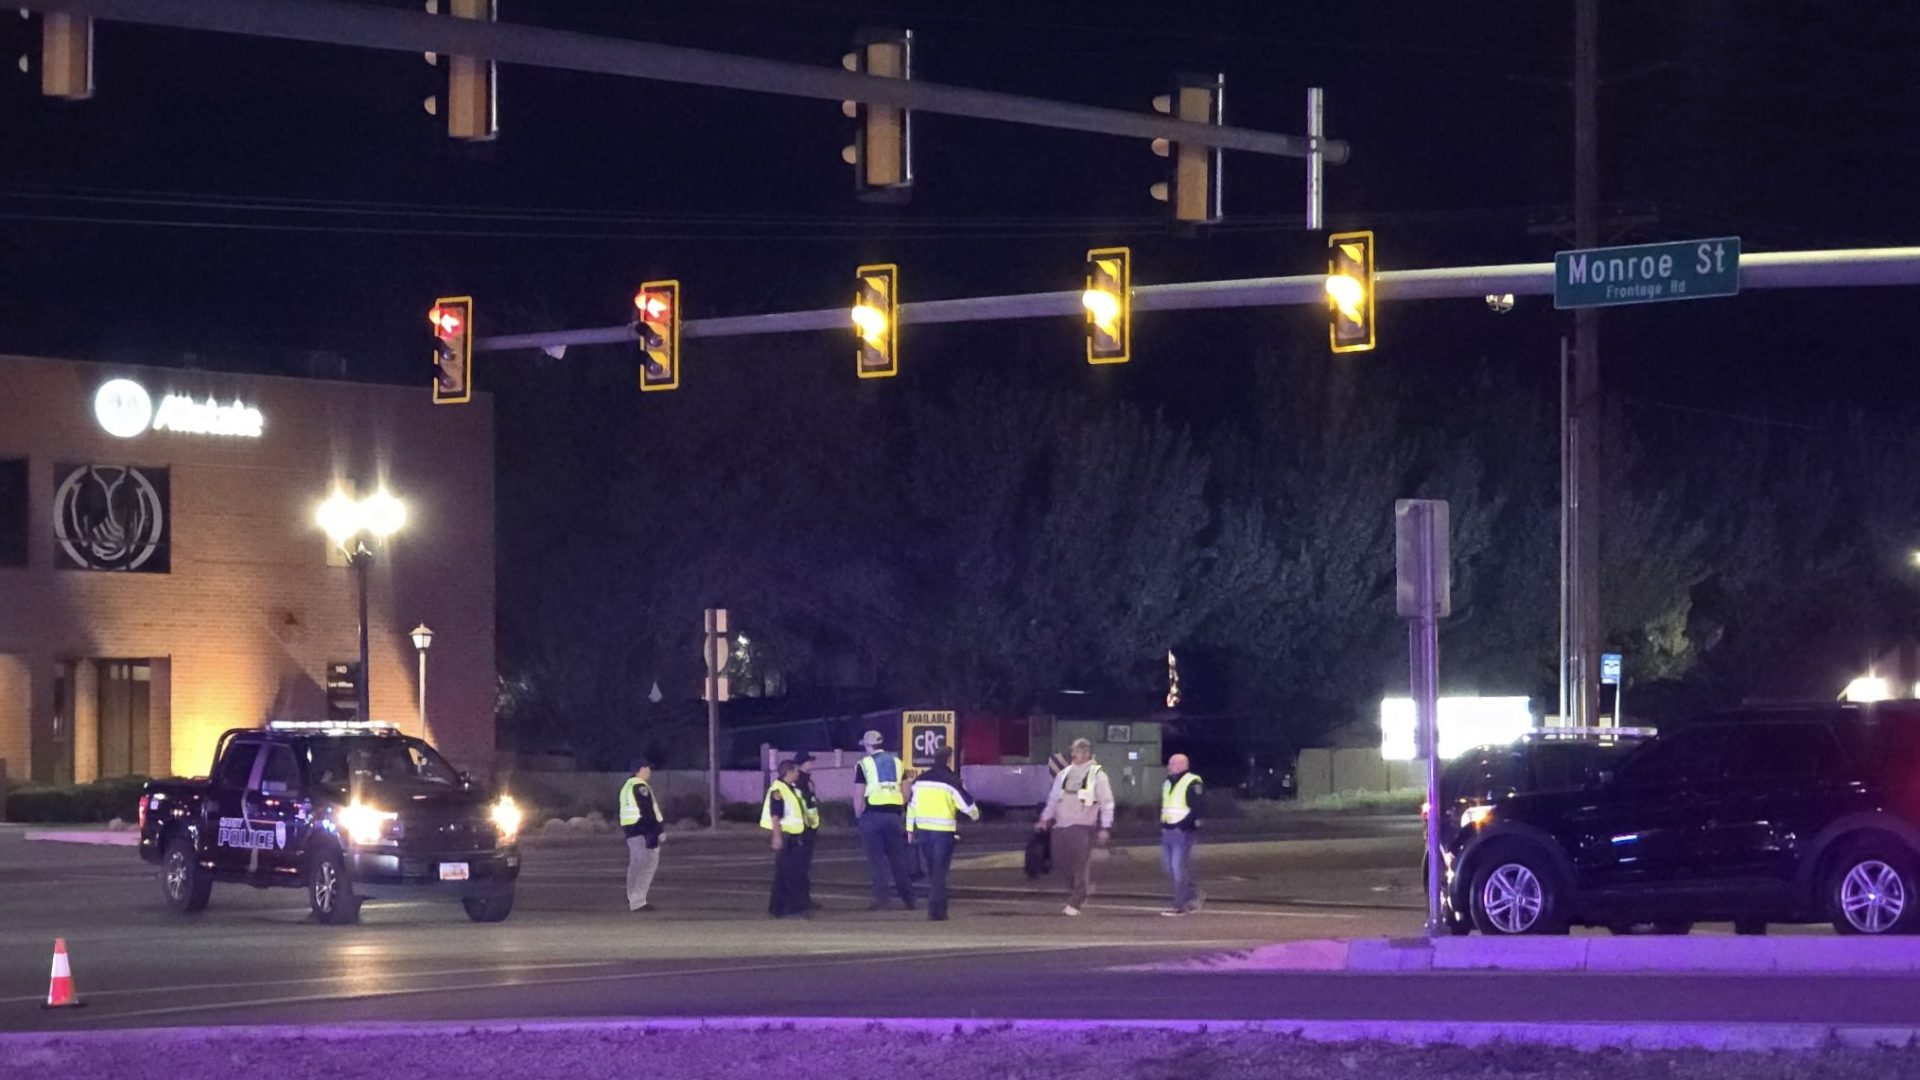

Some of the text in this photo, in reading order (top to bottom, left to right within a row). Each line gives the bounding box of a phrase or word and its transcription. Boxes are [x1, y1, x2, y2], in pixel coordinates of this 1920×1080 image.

[1568, 242, 1725, 285] Monroe St
[1606, 279, 1686, 299] Frontage Rd
[907, 713, 952, 724] AVAILABLE
[217, 827, 275, 850] POLICE
